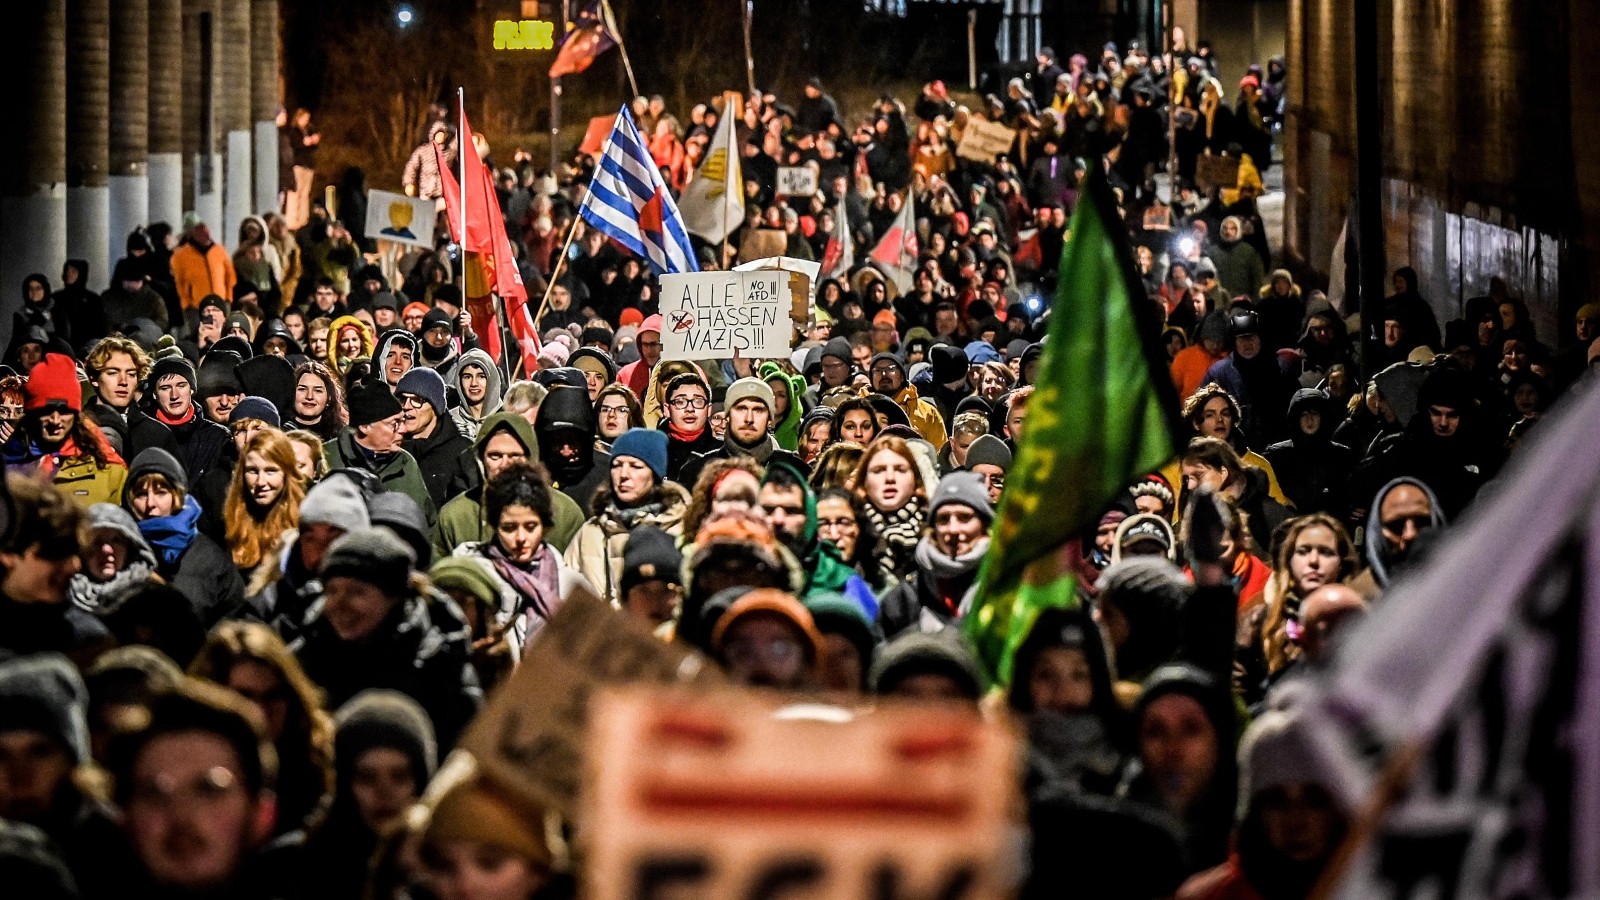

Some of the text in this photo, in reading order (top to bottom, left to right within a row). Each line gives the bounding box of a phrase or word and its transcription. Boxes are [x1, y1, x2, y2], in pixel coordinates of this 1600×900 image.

[750, 280, 764, 290] NO
[681, 283, 737, 309] ALLE
[747, 290, 769, 301] AFD
[698, 307, 777, 327] HASSEN
